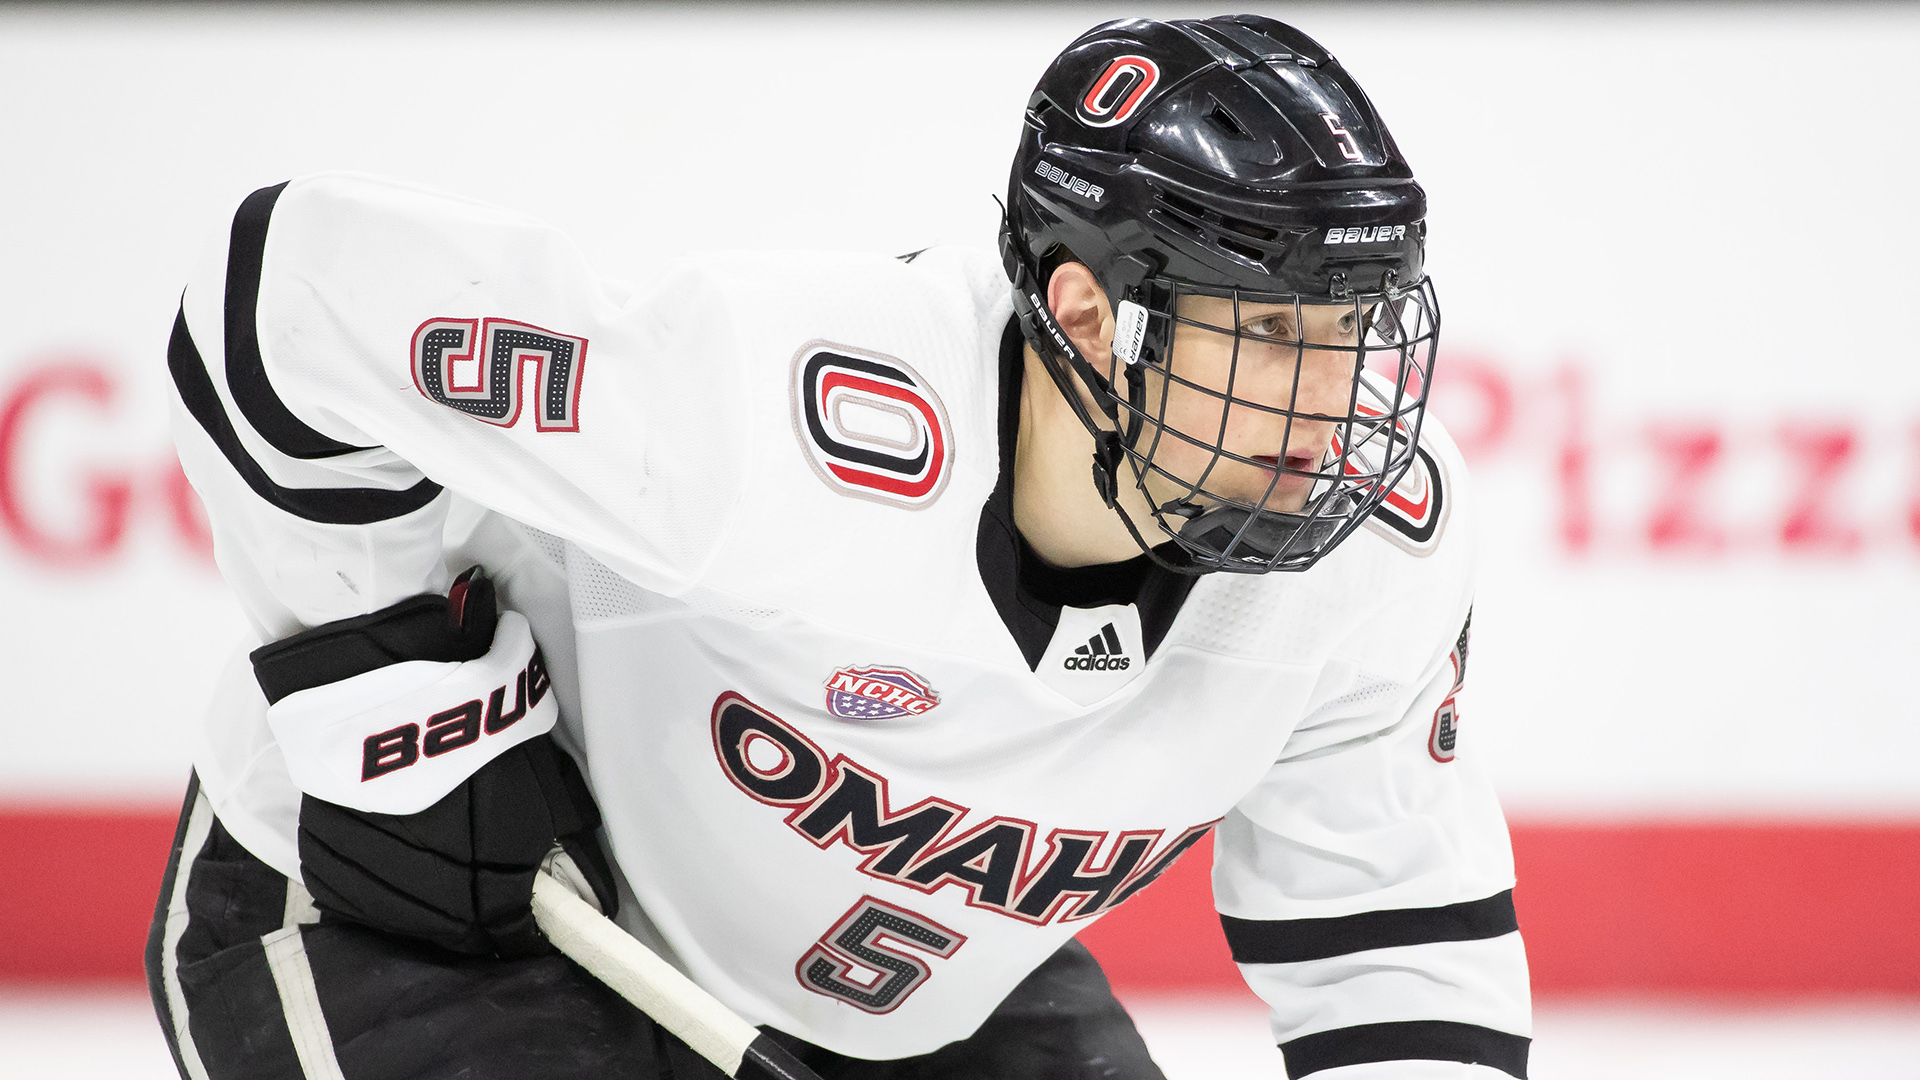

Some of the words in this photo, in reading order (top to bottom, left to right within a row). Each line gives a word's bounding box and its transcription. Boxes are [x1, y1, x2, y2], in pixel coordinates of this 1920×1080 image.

[1318, 112, 1364, 160] 5
[1034, 160, 1105, 202] BAUER
[1324, 225, 1406, 244] BAUER
[1030, 293, 1075, 360] BAUER
[1130, 310, 1145, 361] BAUER
[410, 317, 588, 433] 5
[1376, 344, 1920, 562] Pizz
[1063, 654, 1130, 671] adidas
[830, 675, 935, 713] NCHC
[795, 893, 968, 1015] 5
